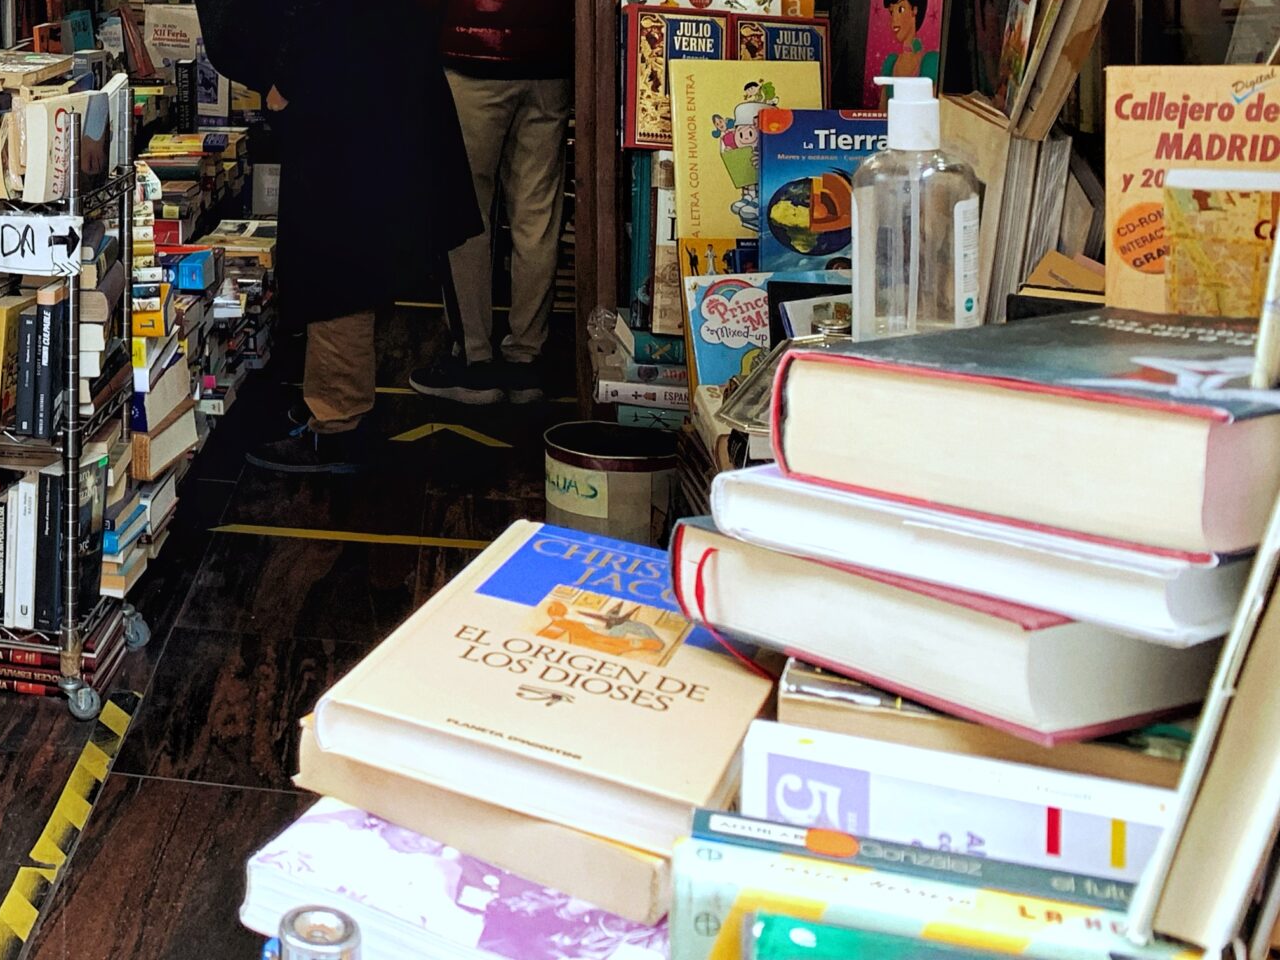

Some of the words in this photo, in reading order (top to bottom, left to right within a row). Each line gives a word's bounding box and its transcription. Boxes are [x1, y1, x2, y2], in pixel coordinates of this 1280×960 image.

[153, 29, 165, 37] XII
[167, 29, 188, 39] Feria
[676, 22, 711, 38] JULIO
[776, 30, 811, 46] JULIO
[674, 38, 714, 53] VERNE
[774, 46, 815, 61] VERNE
[687, 74, 696, 115] ENTRA
[1232, 69, 1277, 95] Digital
[1115, 91, 1234, 129] Callejero
[1245, 93, 1280, 123] de
[688, 117, 699, 157] HUMOR
[803, 142, 814, 150] La
[814, 129, 889, 151] Tierra
[1155, 133, 1280, 162] MADRID
[688, 160, 700, 189] CON
[1122, 173, 1134, 192] y
[689, 192, 701, 227] LETRA
[42, 310, 51, 345] CULPABLE
[708, 326, 768, 347] Mixed-up
[454, 624, 494, 648] EL
[502, 634, 648, 685] ORIGEN
[658, 674, 711, 704] DE
[459, 643, 532, 674] LOS
[537, 663, 675, 713] DIOSES
[445, 716, 505, 740] PLANETA
